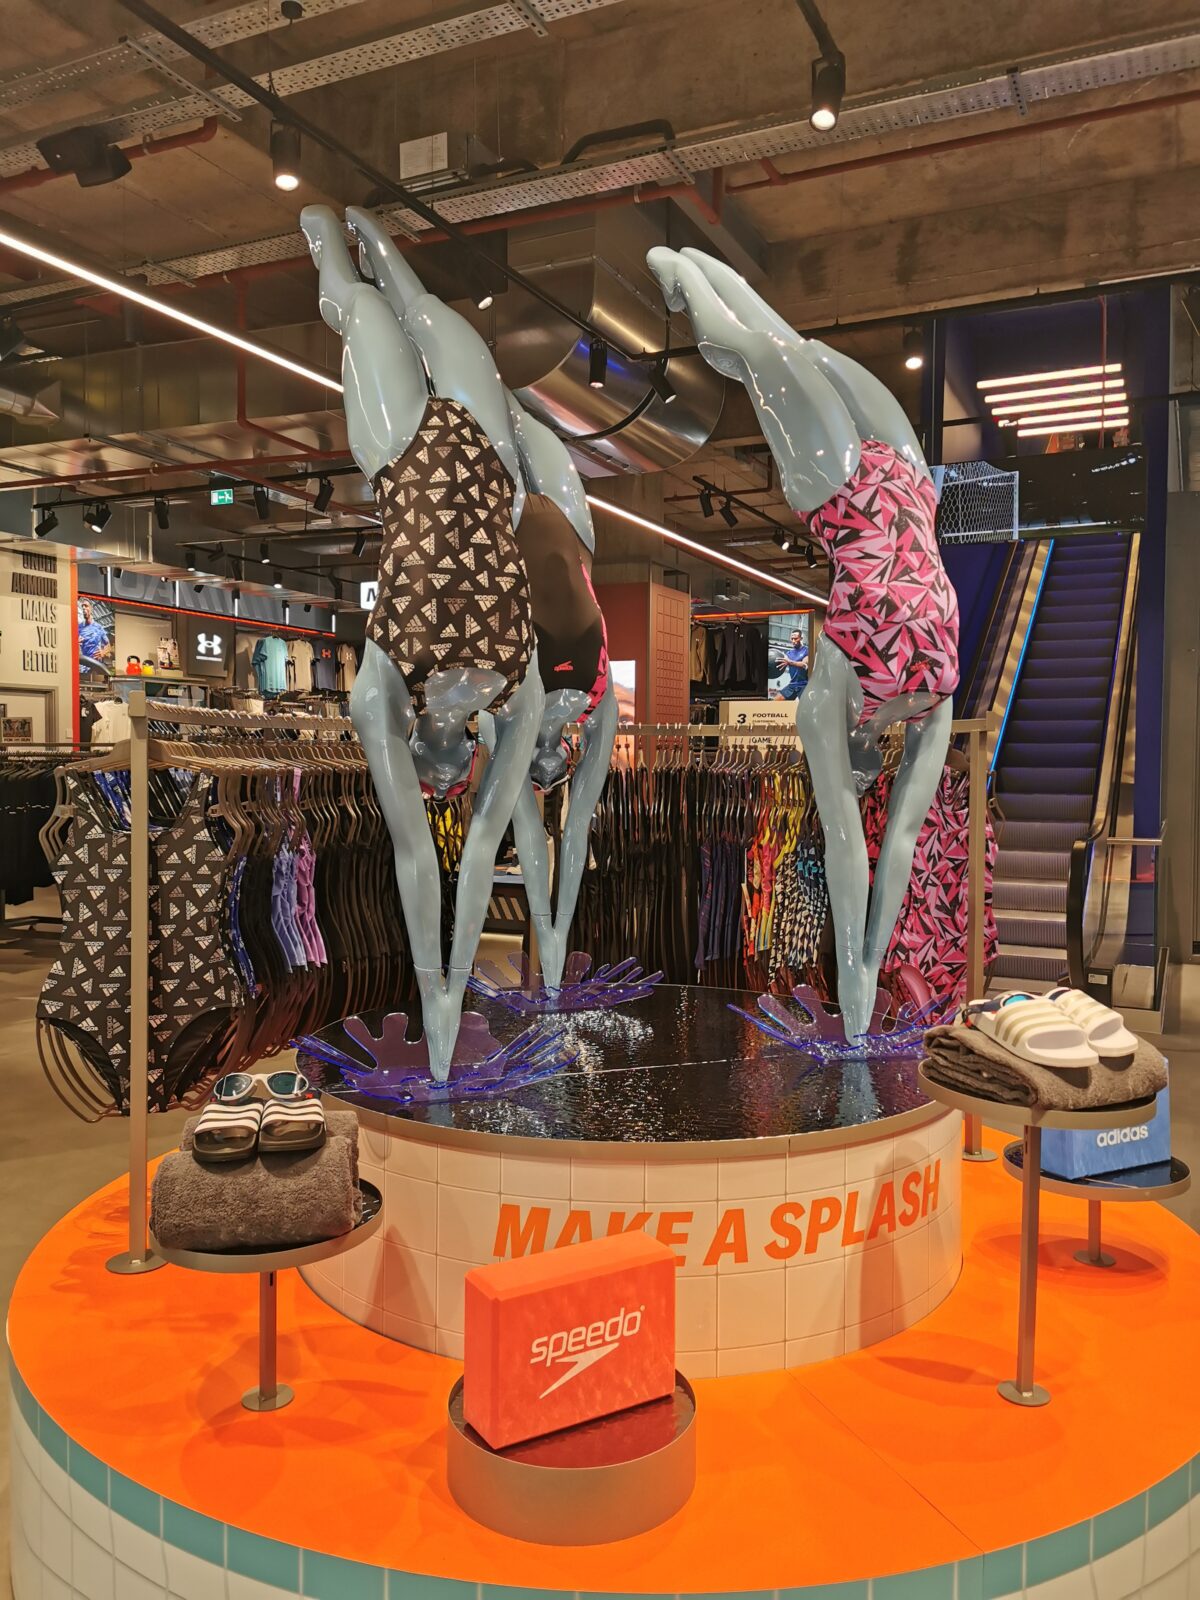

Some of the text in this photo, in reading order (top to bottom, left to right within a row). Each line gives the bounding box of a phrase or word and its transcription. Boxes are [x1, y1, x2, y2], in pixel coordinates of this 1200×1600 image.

[11, 572, 57, 598] ARMOUR
[21, 598, 57, 624] MAKES
[36, 626, 57, 648] YOU
[22, 650, 58, 673] BETTER
[737, 713, 747, 724] 3
[1097, 1125, 1148, 1148] adidas
[702, 1208, 749, 1266] A
[764, 1159, 940, 1260] SPLASH
[530, 1307, 641, 1367] speedo
